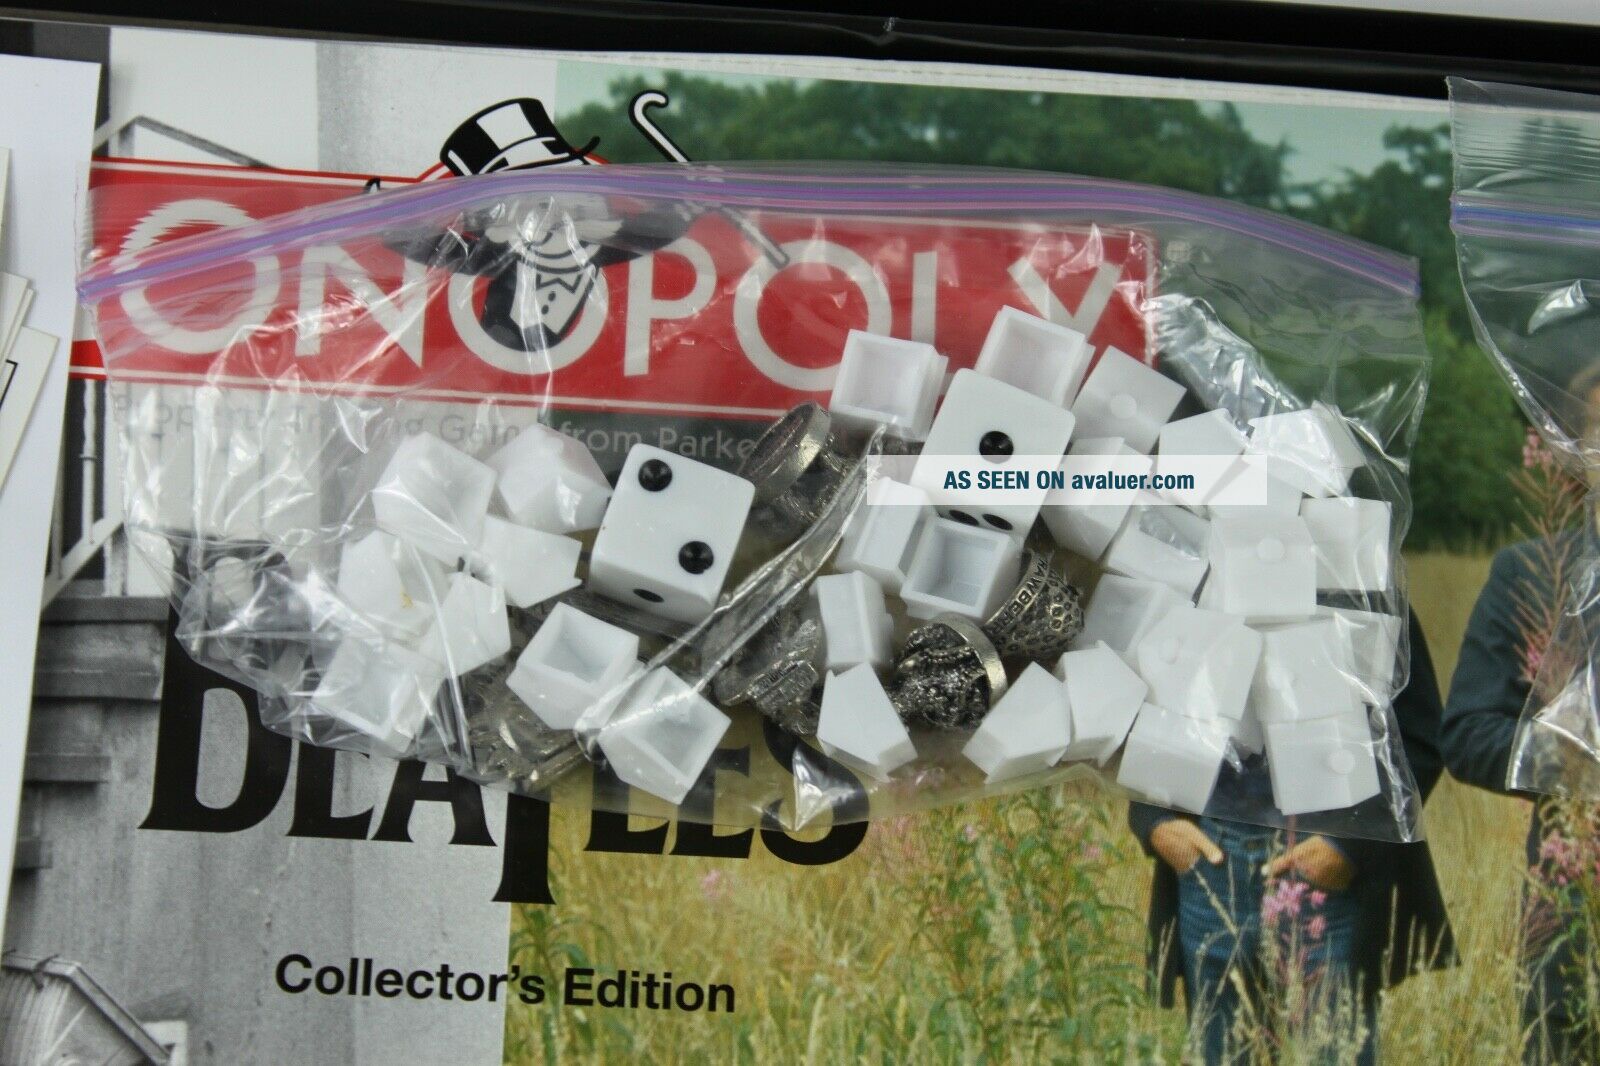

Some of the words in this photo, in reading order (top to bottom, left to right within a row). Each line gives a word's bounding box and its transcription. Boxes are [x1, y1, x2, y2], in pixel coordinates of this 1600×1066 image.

[559, 421, 641, 451] from
[274, 953, 545, 1004] Collector's
[563, 967, 735, 1013] Edition
